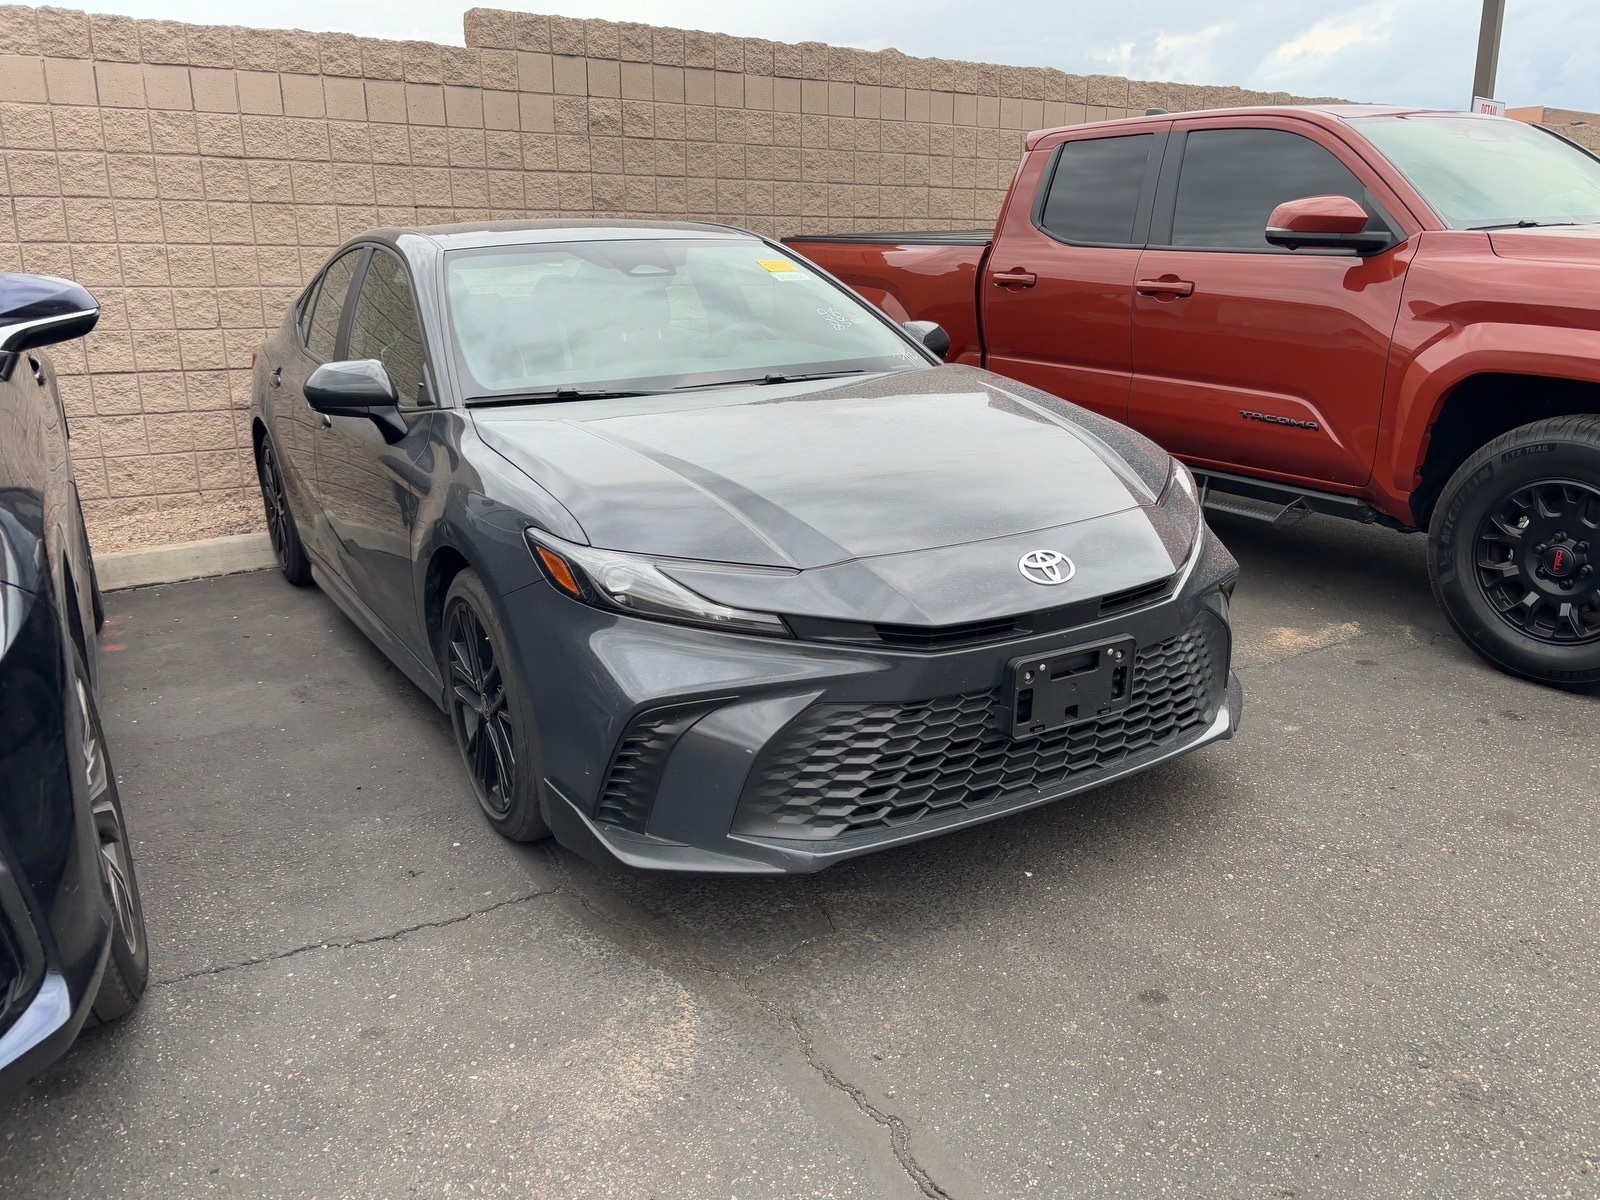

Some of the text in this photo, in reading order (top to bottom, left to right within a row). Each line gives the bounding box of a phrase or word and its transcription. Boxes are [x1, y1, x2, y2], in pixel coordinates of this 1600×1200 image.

[1239, 410, 1319, 431] TACOMA
[1505, 444, 1549, 461] LTX TRAIL
[1553, 549, 1563, 573] TRD
